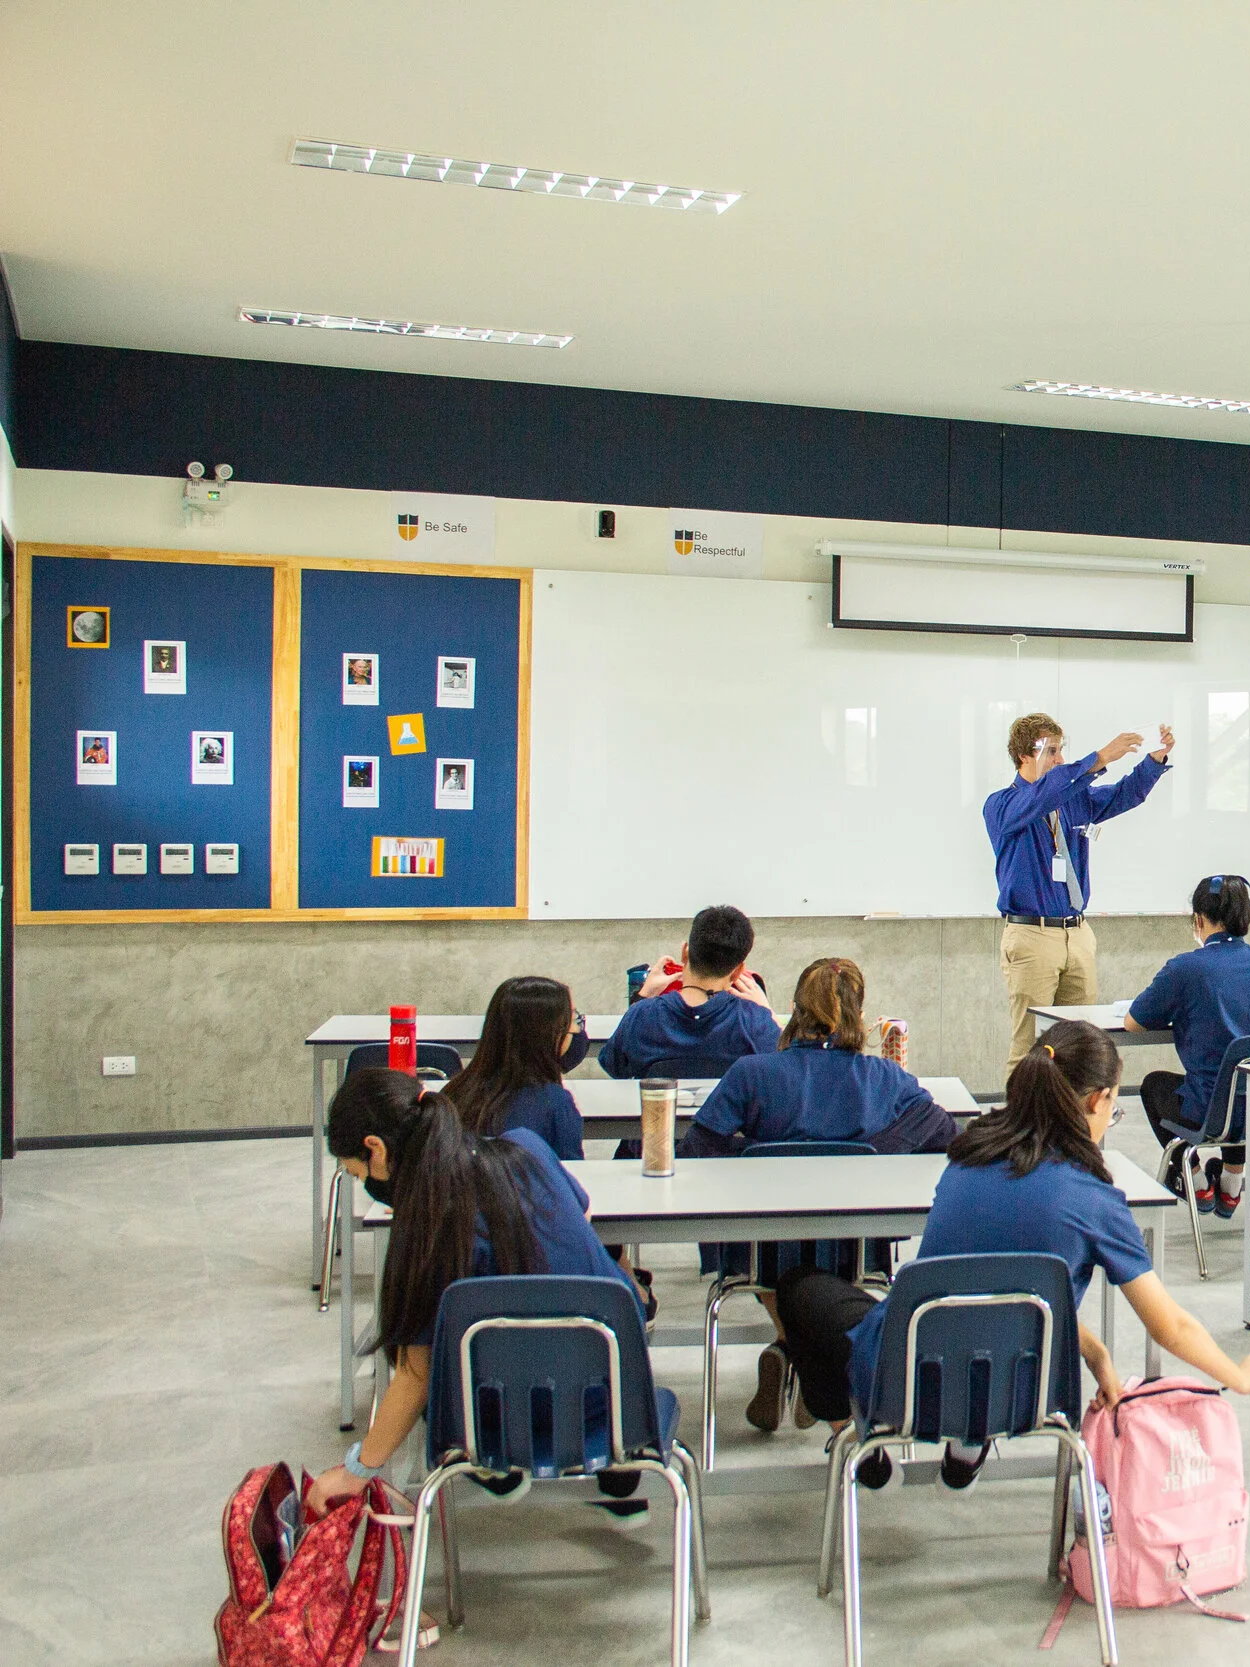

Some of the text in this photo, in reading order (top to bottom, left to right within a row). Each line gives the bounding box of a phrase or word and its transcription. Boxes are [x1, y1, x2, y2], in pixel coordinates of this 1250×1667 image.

[425, 521, 468, 533] Be Safe
[694, 531, 708, 541] Be
[694, 544, 746, 557] Respectful
